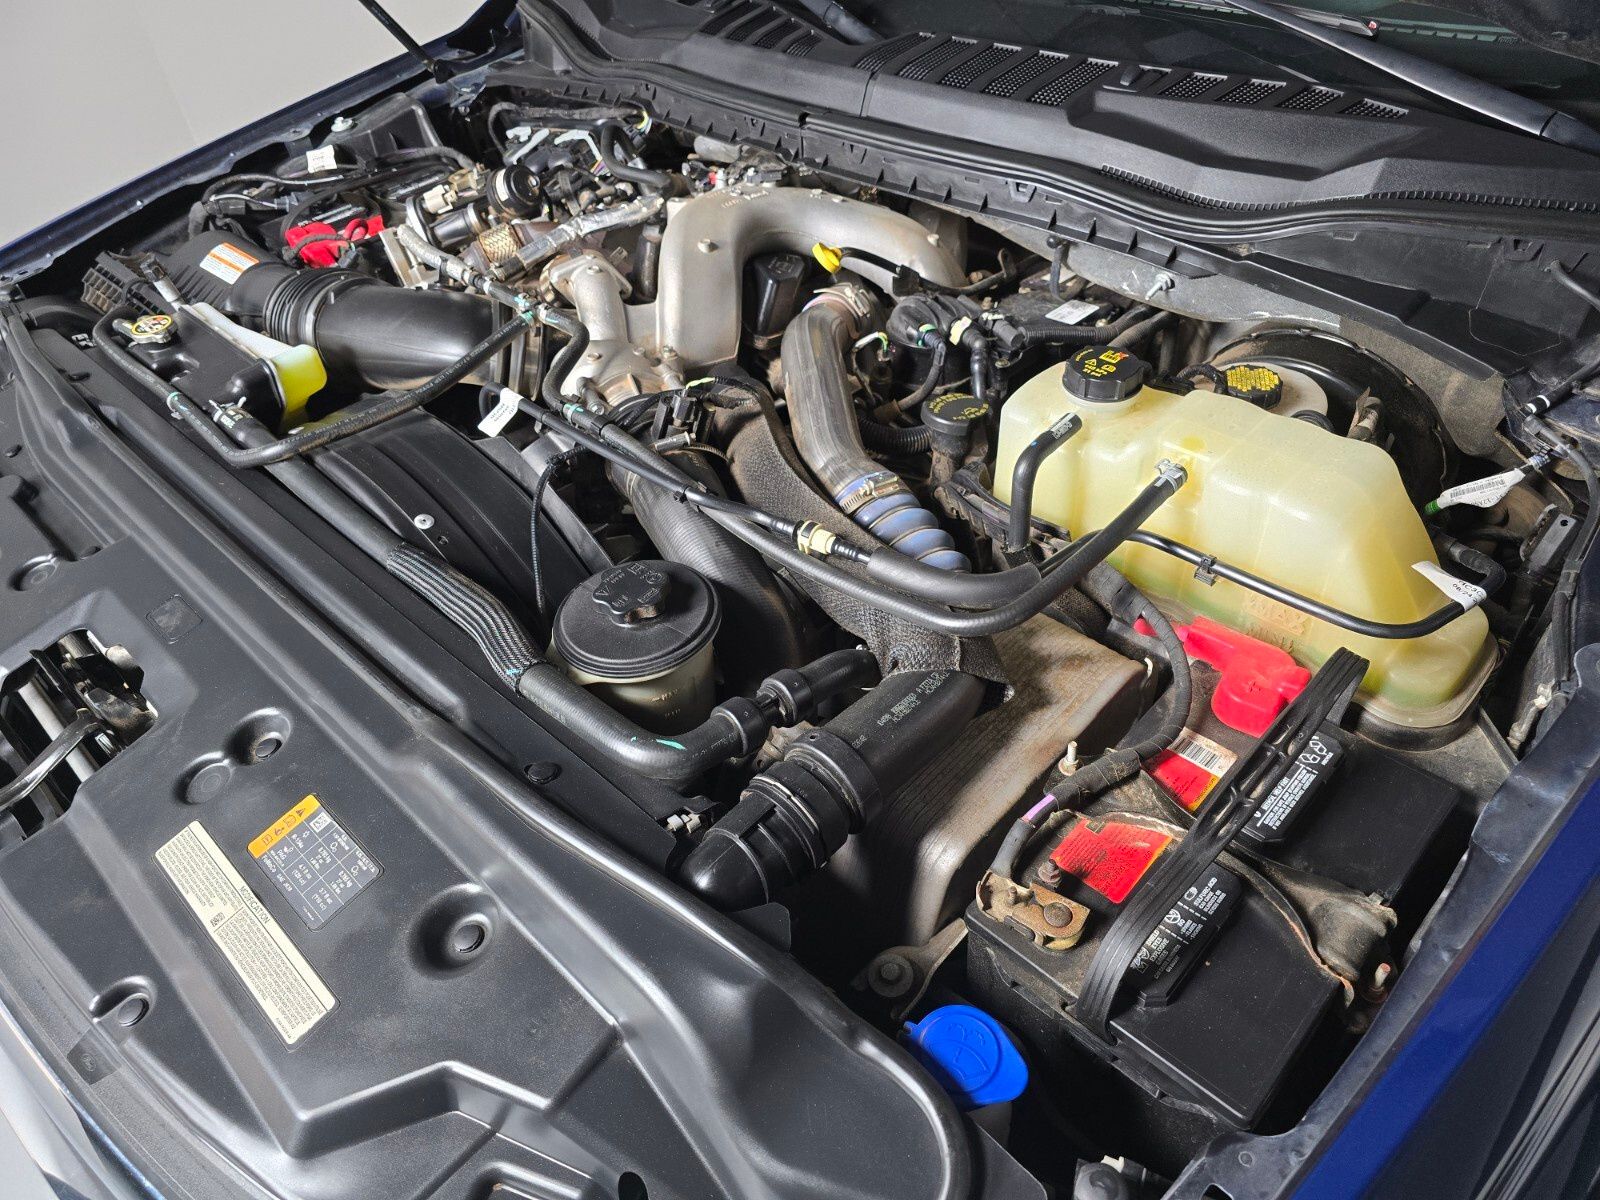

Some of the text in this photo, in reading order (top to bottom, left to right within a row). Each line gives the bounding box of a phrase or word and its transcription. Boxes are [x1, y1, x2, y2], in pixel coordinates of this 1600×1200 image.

[238, 885, 270, 924] MODIFICATION
[1193, 876, 1217, 906] SULFURIC ACID
[1149, 937, 1169, 961] EXPLOSIVE
